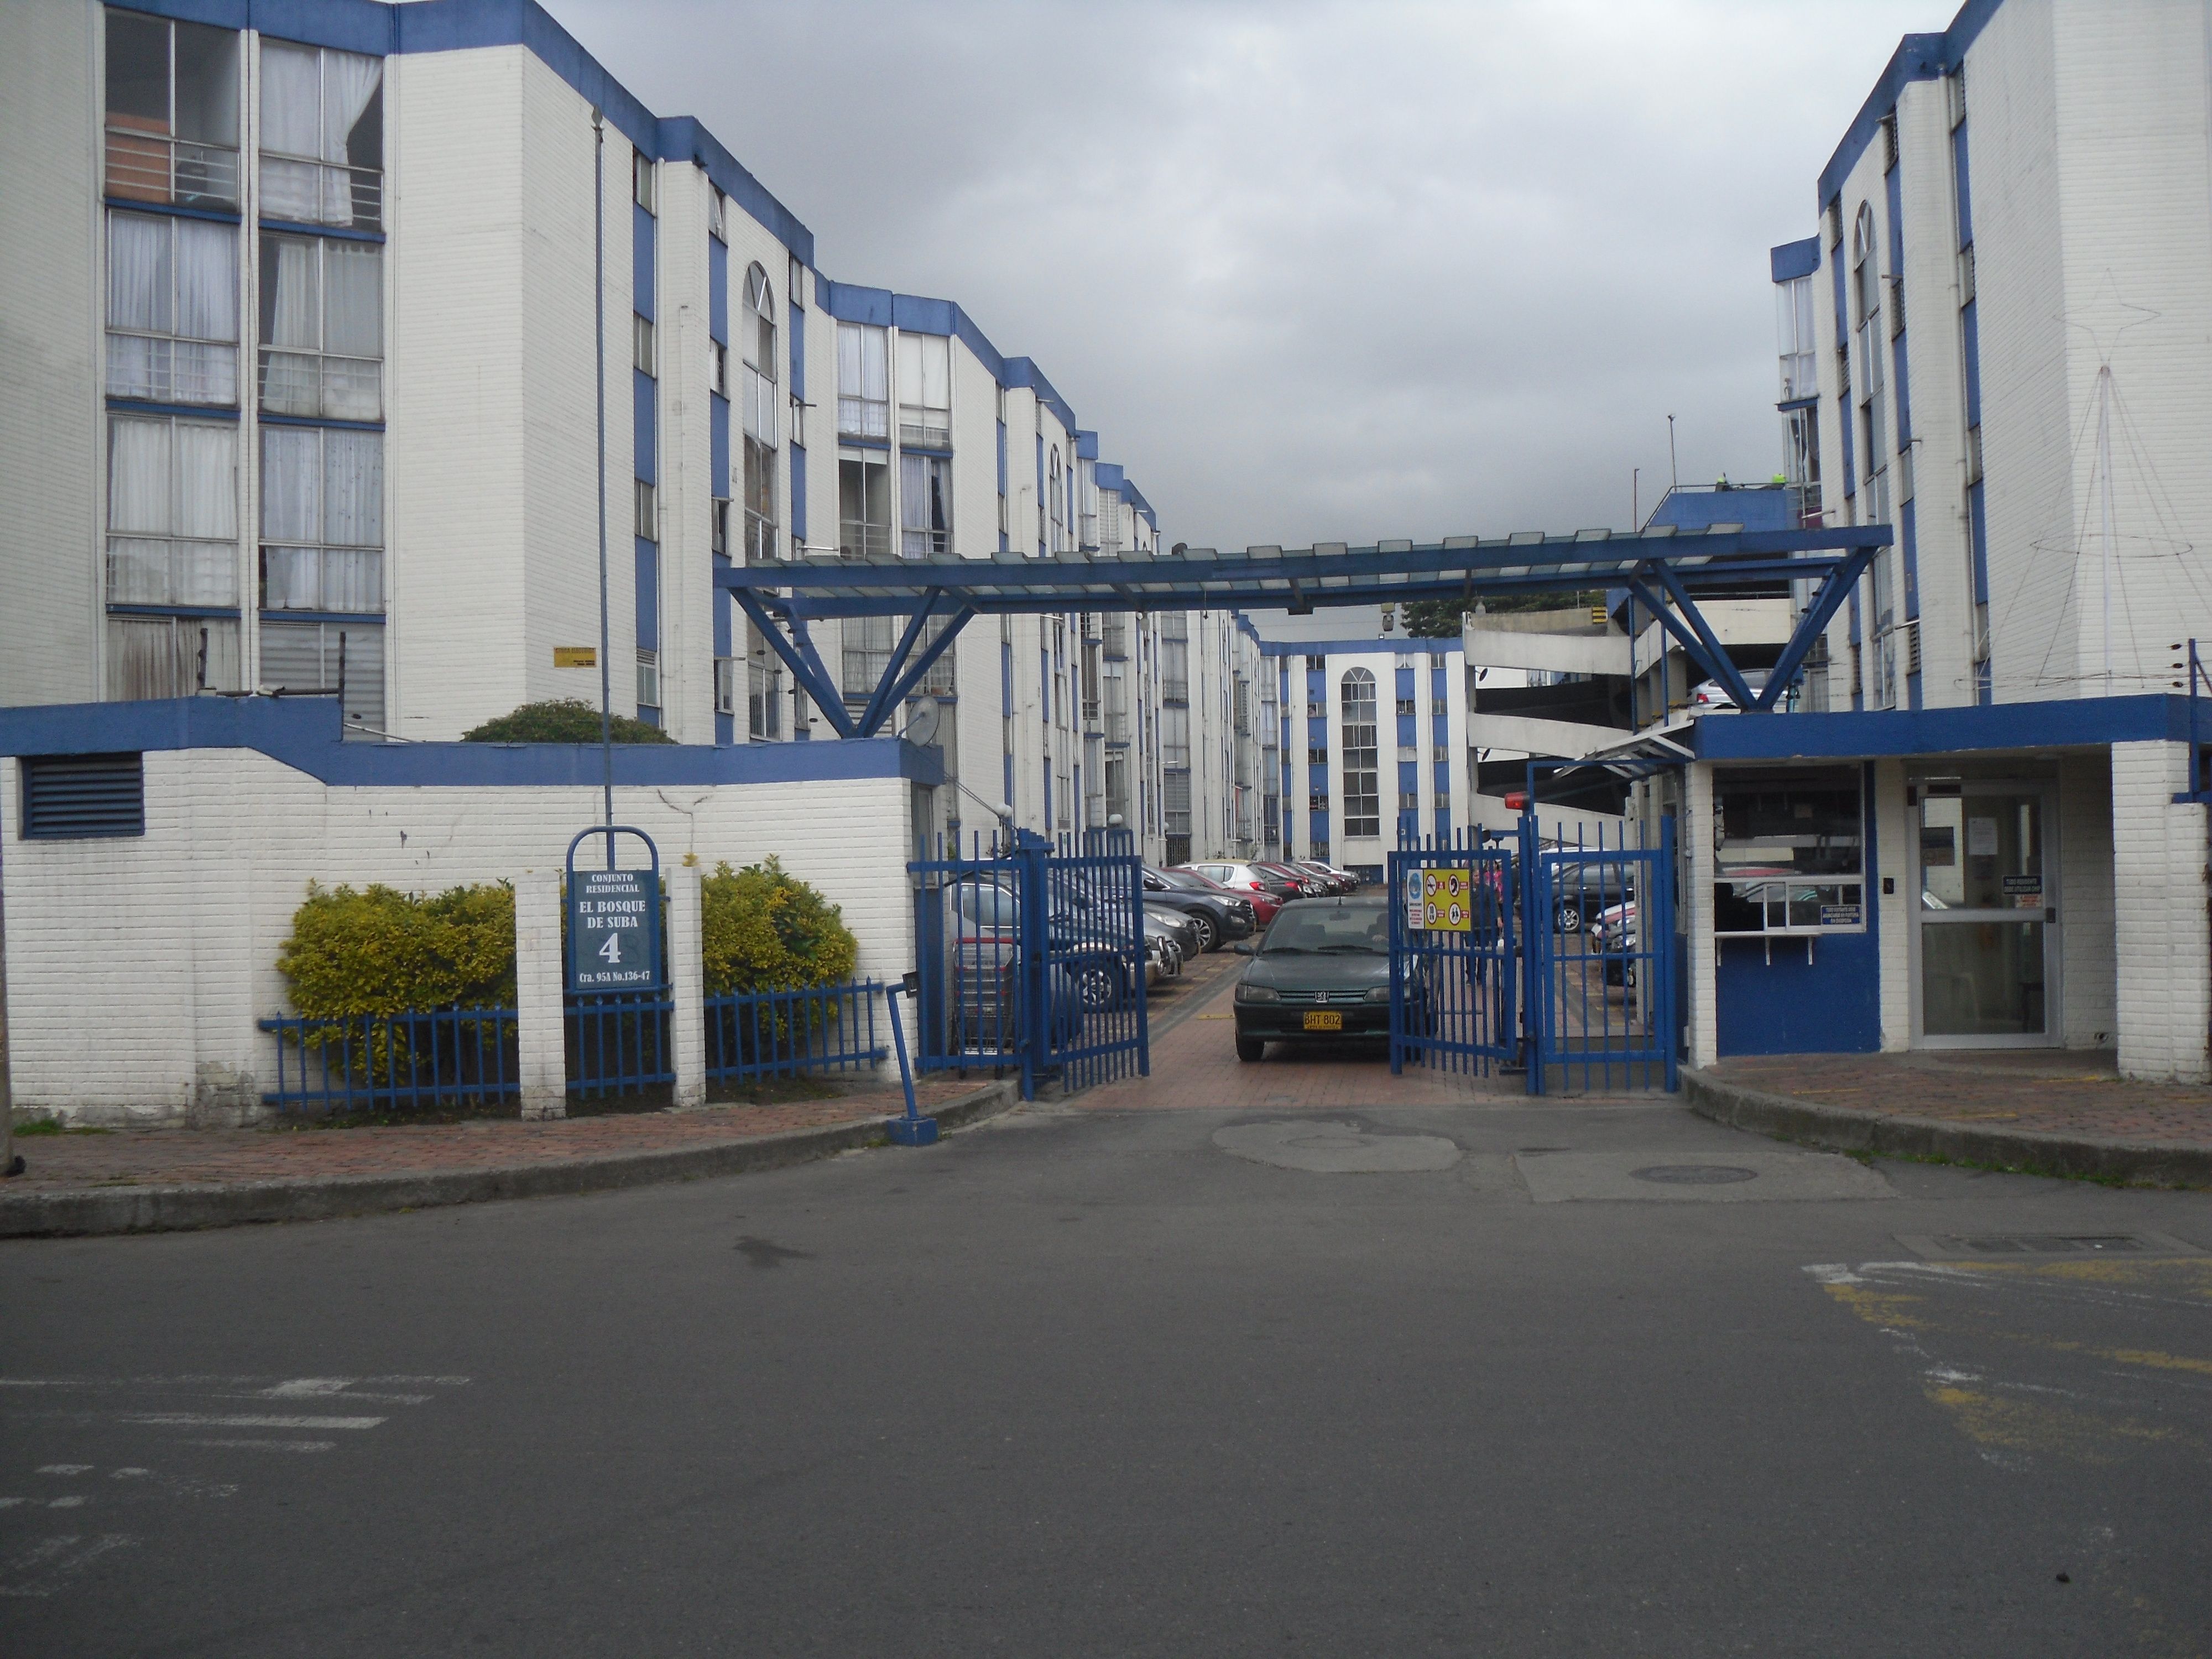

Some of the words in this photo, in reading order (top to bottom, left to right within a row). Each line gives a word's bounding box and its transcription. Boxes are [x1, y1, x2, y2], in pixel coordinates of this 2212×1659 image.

[592, 874, 633, 883] CONJUNTO
[586, 884, 640, 893] RESIDENCIAL
[580, 901, 593, 913] EL
[597, 900, 645, 913] BOSQUE
[587, 917, 604, 928] DE
[607, 916, 638, 928] SUBA
[599, 932, 621, 963] 4
[580, 973, 594, 982] Cra.
[597, 972, 611, 982] 95A
[1324, 1015, 1341, 1024] 802
